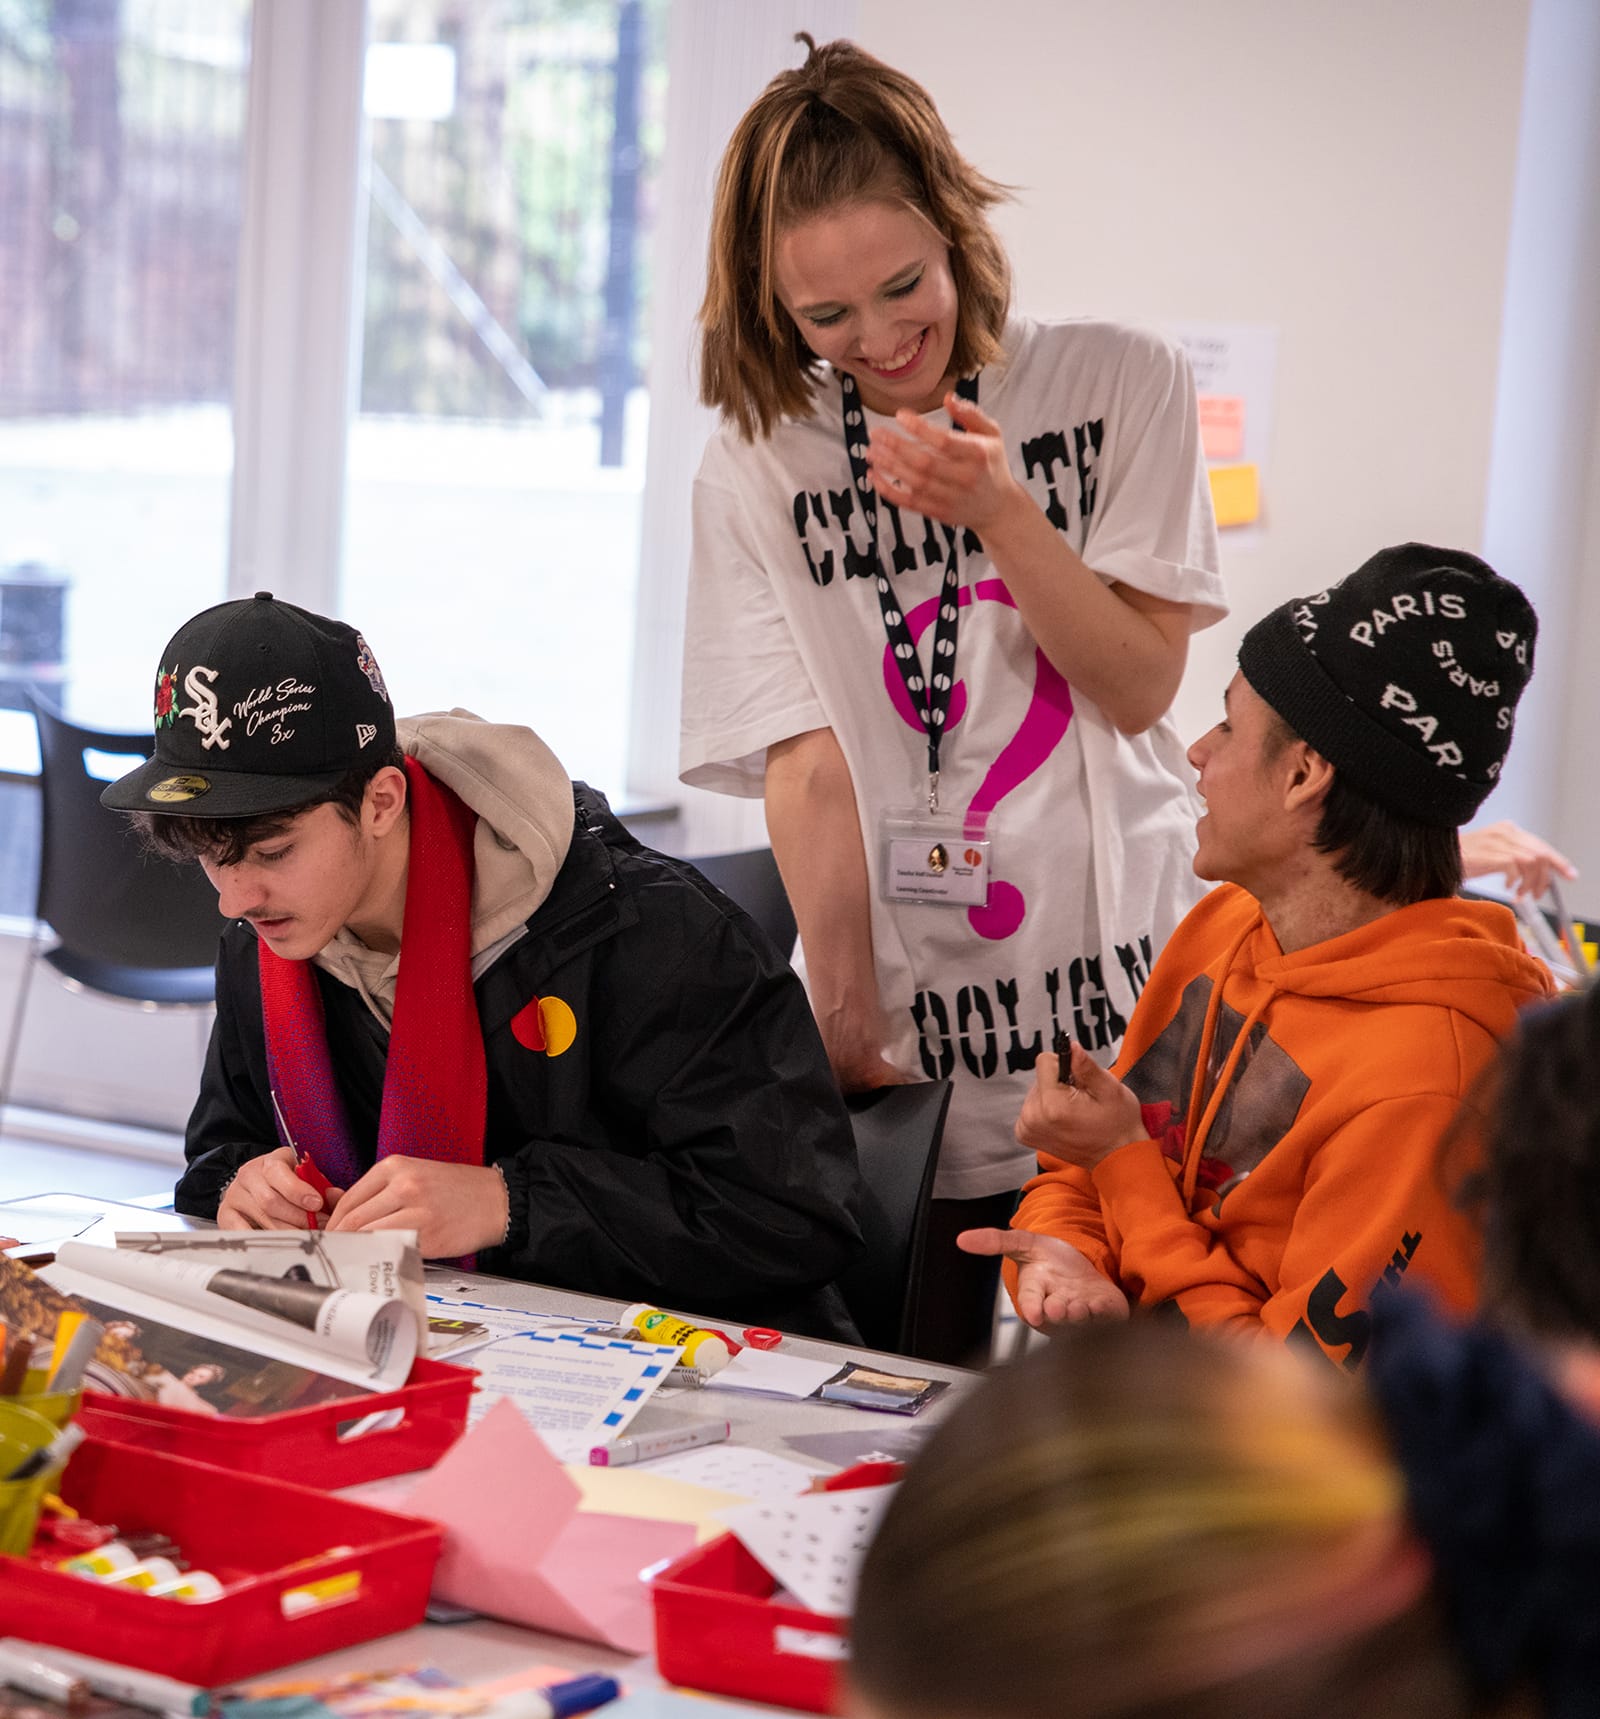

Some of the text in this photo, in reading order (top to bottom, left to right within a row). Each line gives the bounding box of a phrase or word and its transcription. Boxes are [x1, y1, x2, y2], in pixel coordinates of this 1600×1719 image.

[1350, 591, 1466, 648] PARIS
[1432, 640, 1500, 698] PARIS
[233, 678, 316, 719] World Series
[246, 702, 312, 737] Champions
[270, 723, 295, 745] 3x
[1381, 683, 1467, 779] PAR
